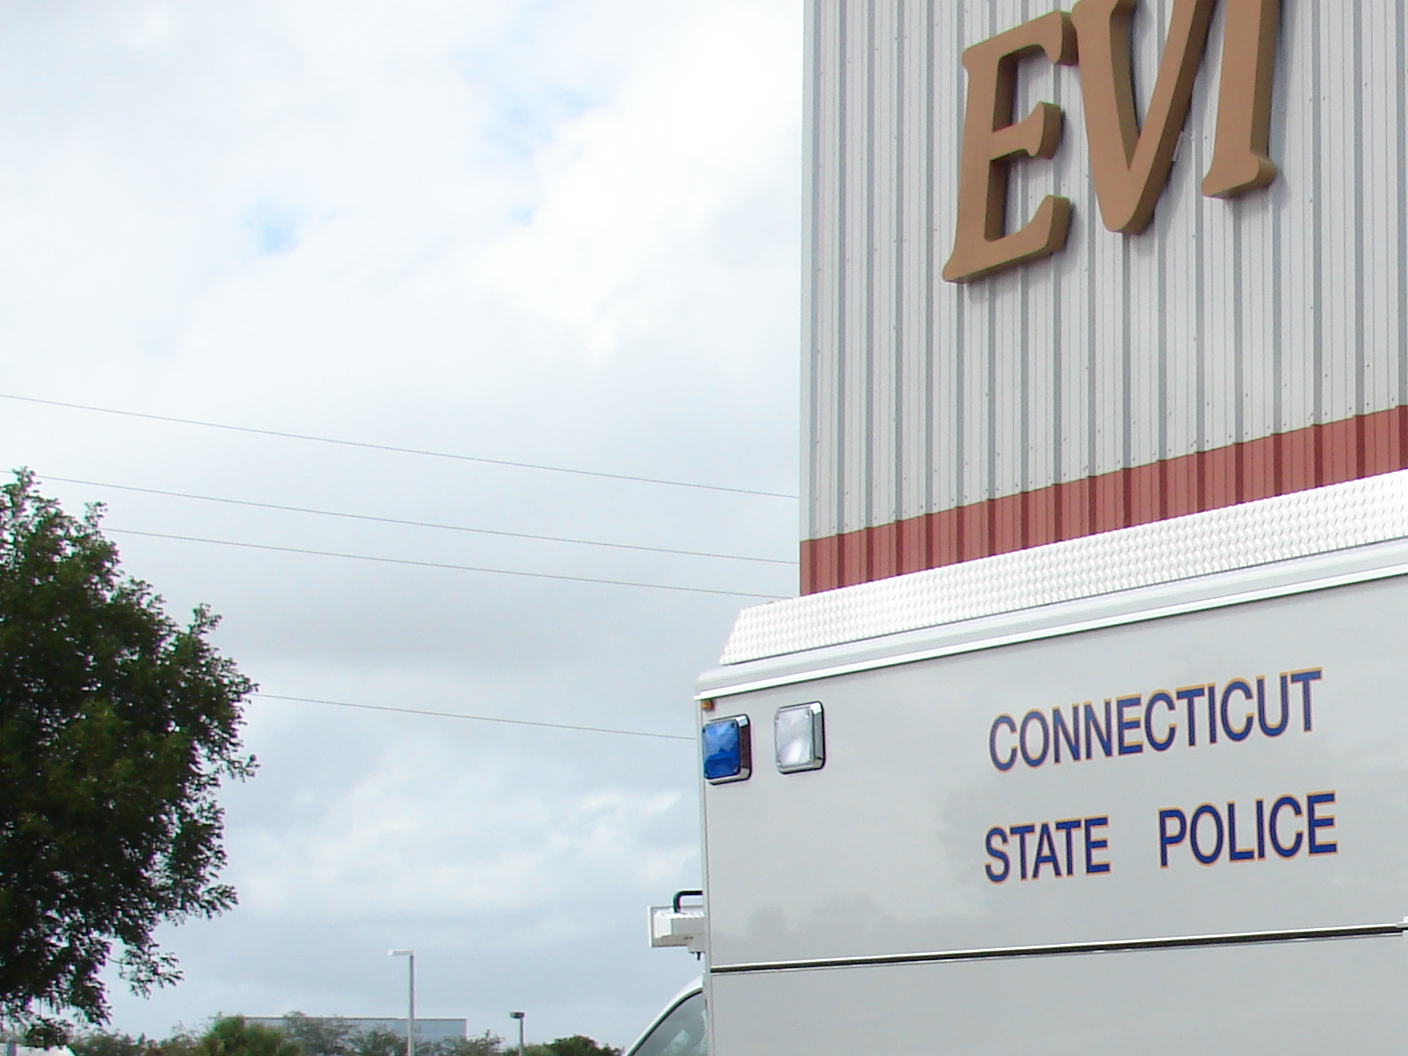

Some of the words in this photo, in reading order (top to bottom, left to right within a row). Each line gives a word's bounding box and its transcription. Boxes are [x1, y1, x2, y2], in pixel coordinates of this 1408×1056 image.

[942, 0, 1278, 284] EVI
[988, 666, 1323, 773] CONNECTICUT
[984, 814, 1112, 885] STATE
[1157, 790, 1339, 869] POLICE
